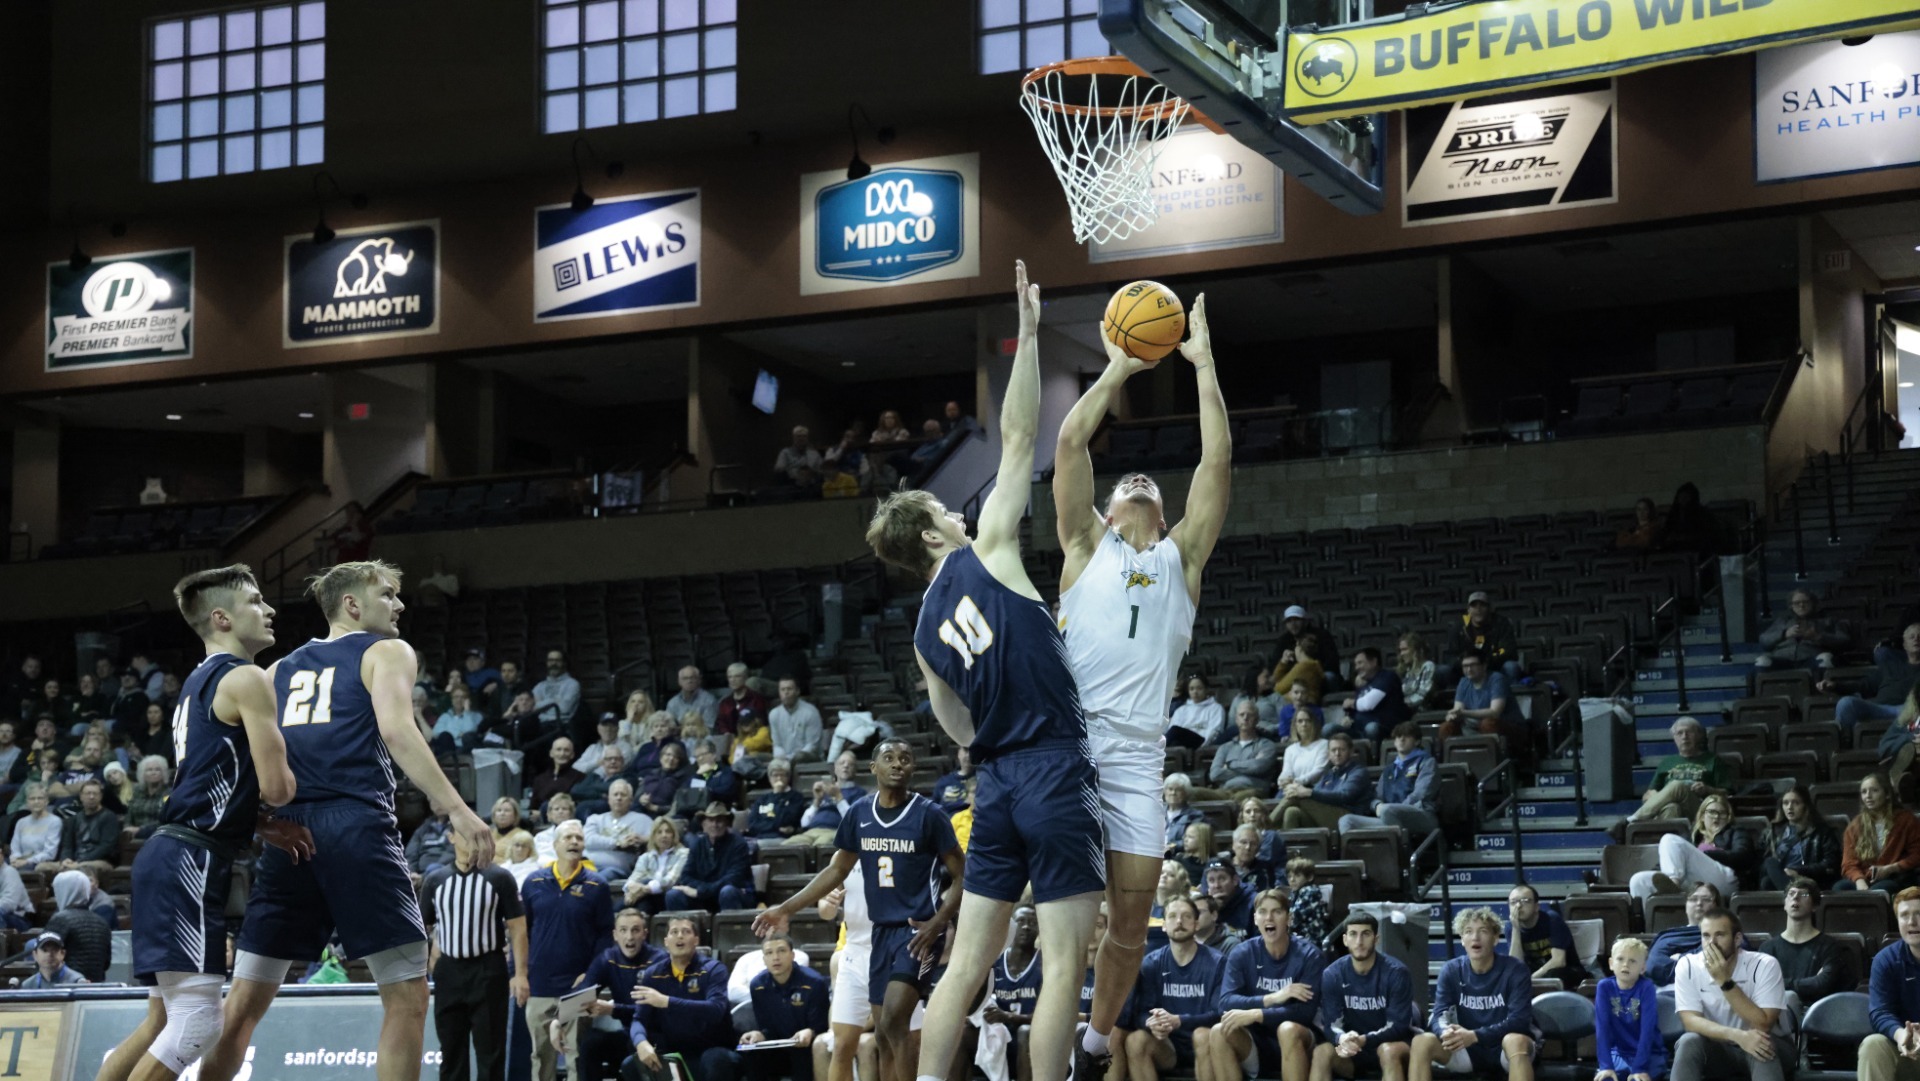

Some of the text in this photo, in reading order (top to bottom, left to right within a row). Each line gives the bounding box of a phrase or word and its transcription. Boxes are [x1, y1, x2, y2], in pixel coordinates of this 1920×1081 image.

[1374, 0, 1774, 77] BUFFALO WIL
[1778, 110, 1885, 135] HEALTH
[1458, 123, 1554, 149] PRIE
[1448, 170, 1563, 190] SIGN COMPANY
[1180, 192, 1264, 212] MEDICINE
[844, 215, 936, 251] MIDCO
[303, 294, 420, 324] MAMMOTH
[62, 314, 178, 337] First PREMIER Bank
[62, 333, 176, 353] PREMIER Bankcard
[938, 595, 994, 671] 10
[1128, 604, 1140, 639] 1
[281, 666, 336, 727] 21
[1549, 776, 1566, 785] 103
[1520, 806, 1536, 815] 103
[861, 837, 916, 853] AUGUSTANA
[1489, 838, 1506, 847] 103
[878, 856, 895, 888] 2
[1454, 873, 1472, 882] 103
